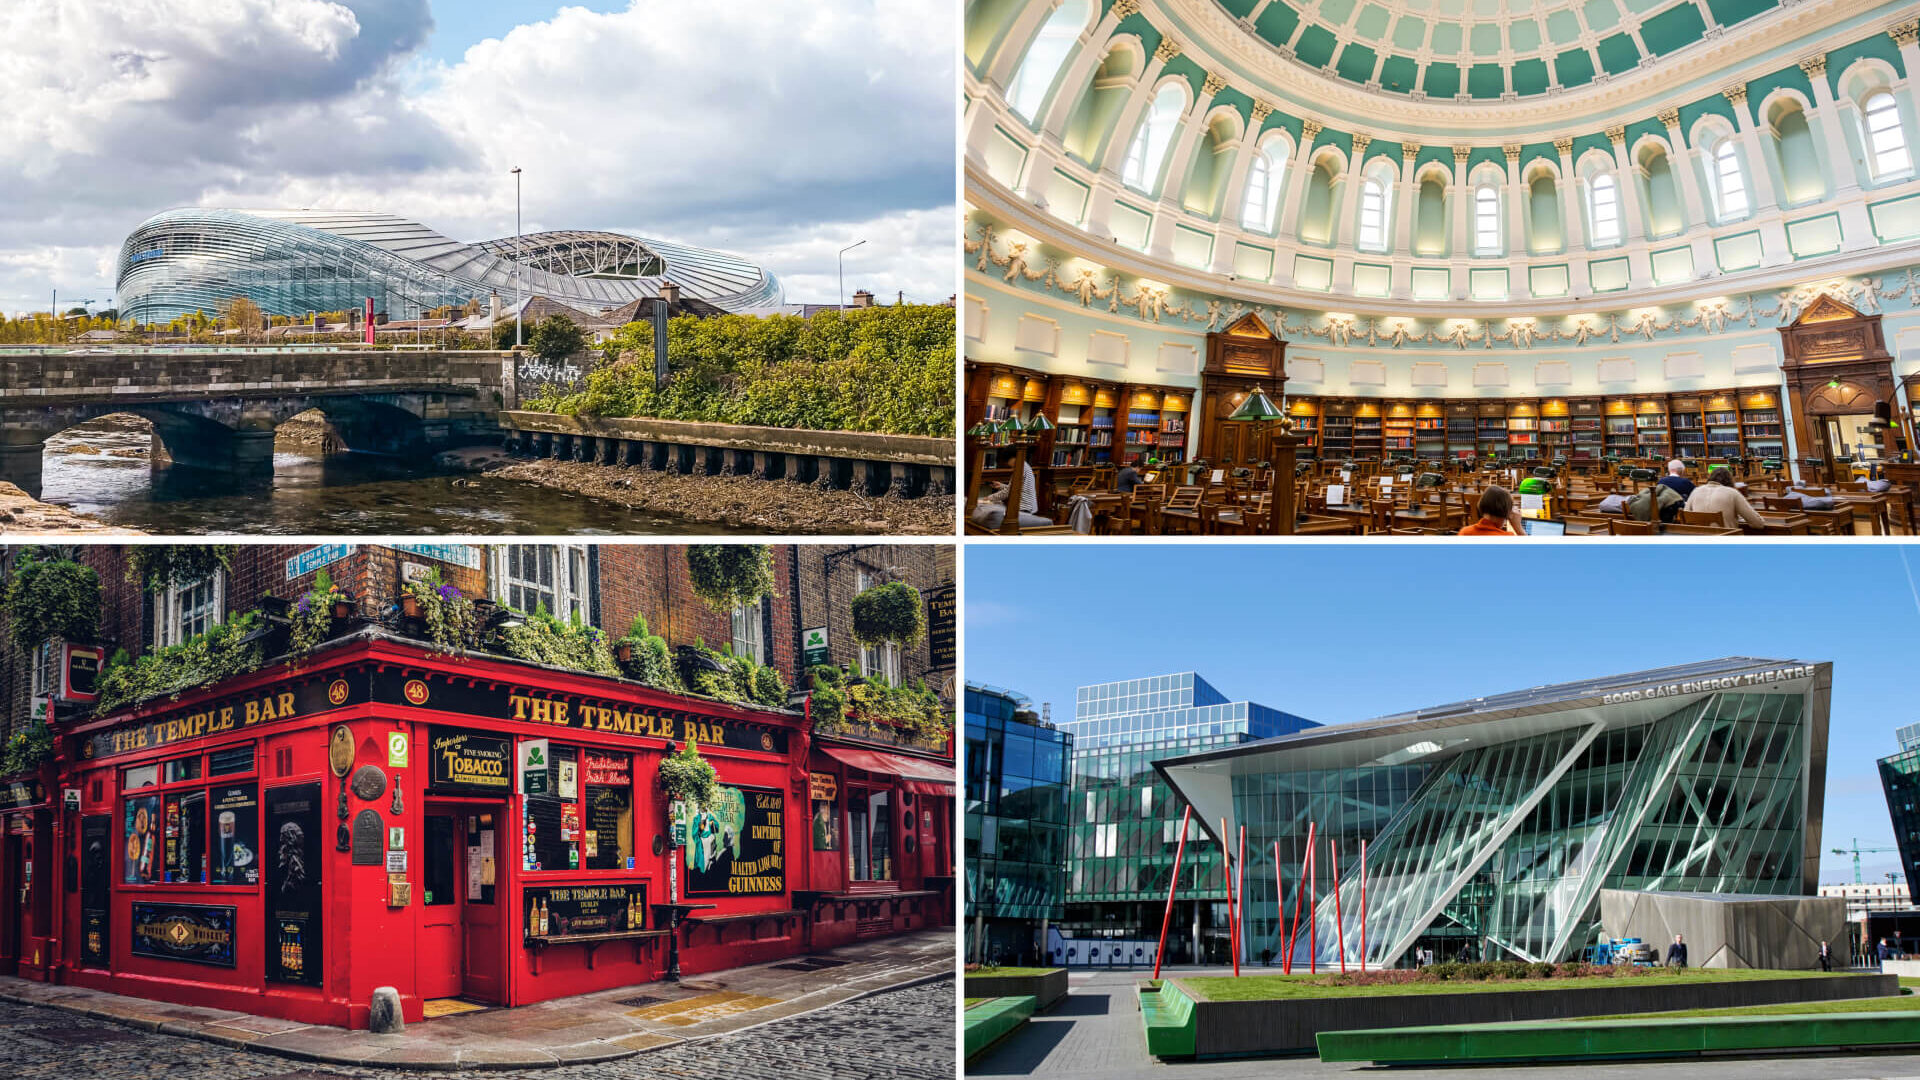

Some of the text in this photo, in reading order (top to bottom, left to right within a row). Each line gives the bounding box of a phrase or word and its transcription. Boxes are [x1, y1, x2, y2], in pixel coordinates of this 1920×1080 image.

[332, 684, 345, 701] 48
[408, 683, 424, 699] 48
[1603, 665, 1816, 706] BORD GÁIS ENERGY THEATRE
[112, 692, 296, 753] THE TEMPLE BAR
[508, 695, 725, 746] THE TEMPLE BAR
[585, 756, 629, 771] Traditional
[585, 770, 631, 785] Irish Music
[720, 791, 734, 803] THE
[720, 811, 735, 824] BAR
[767, 811, 781, 826] THE
[751, 825, 782, 840] EMPEROR
[773, 840, 781, 854] OF
[731, 860, 758, 876] MALTED
[728, 876, 783, 893] GUINNESS
[550, 887, 626, 901] THE TEMPLE BAR
